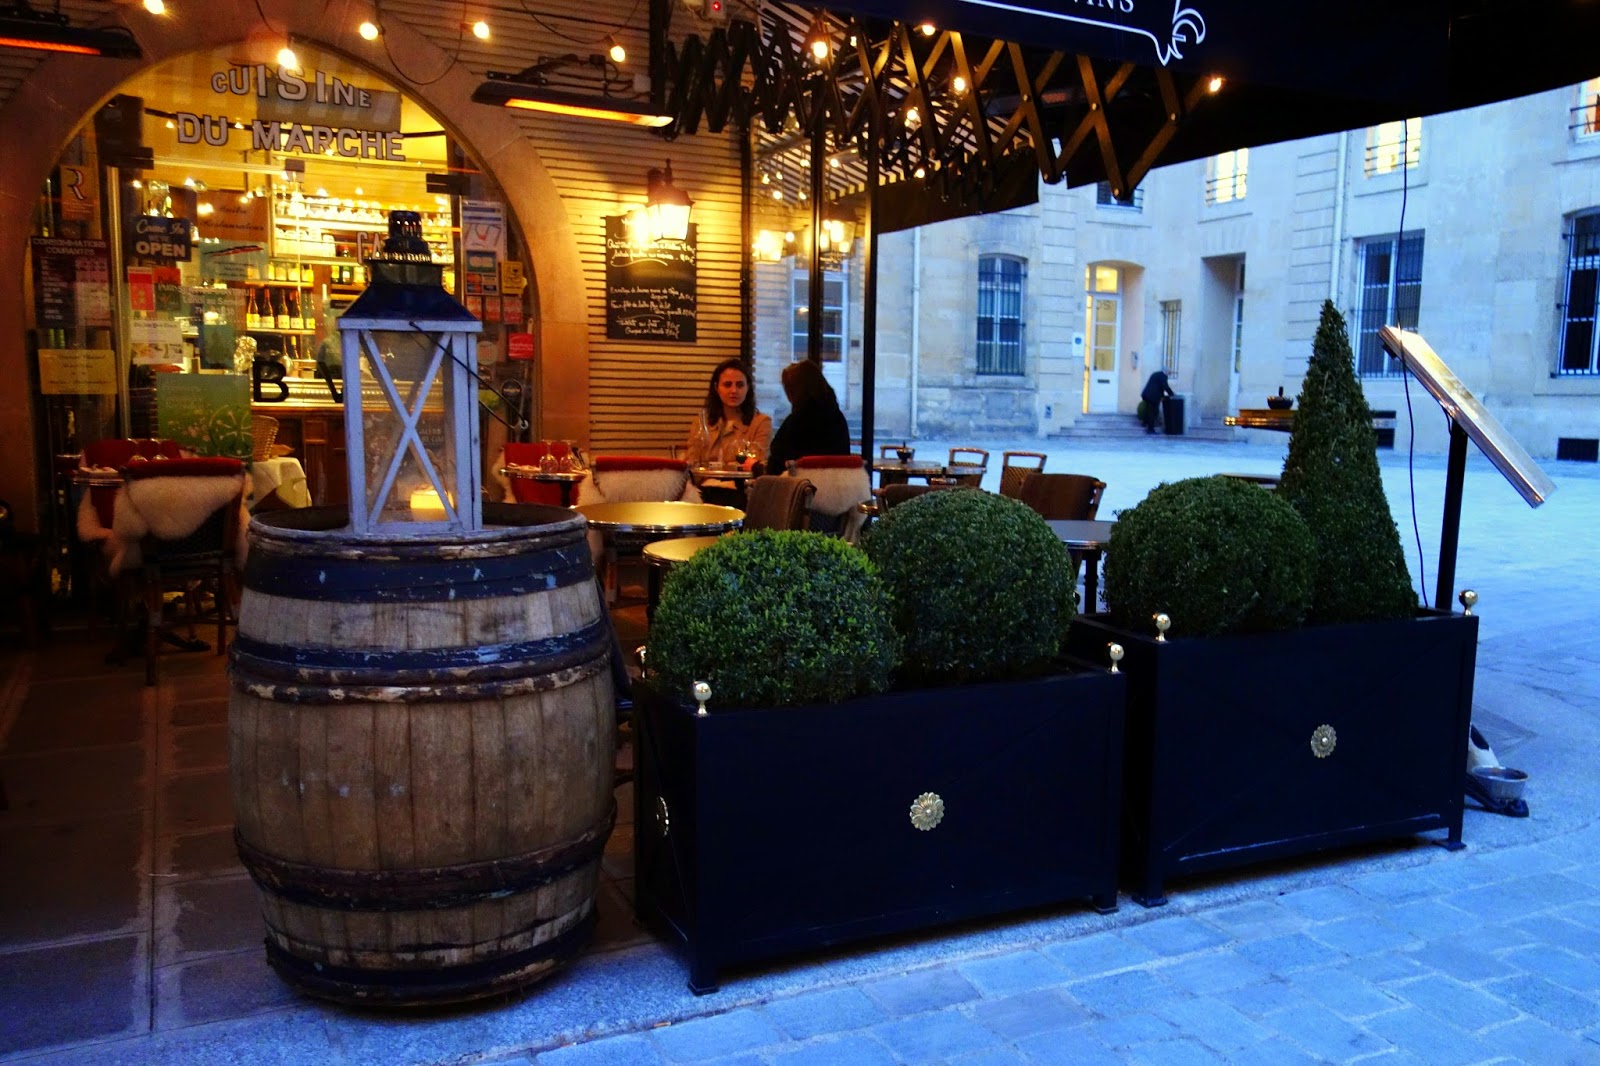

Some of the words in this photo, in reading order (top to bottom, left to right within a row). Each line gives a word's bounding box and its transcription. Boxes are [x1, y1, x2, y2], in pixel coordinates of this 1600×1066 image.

[1074, 0, 1134, 13] NS
[211, 64, 371, 109] CUISINE
[177, 111, 229, 147] DU
[252, 119, 405, 162] MARCHÉ
[32, 238, 107, 249] CONSOMMATIONS
[45, 246, 95, 256] COURANTES
[136, 241, 186, 258] OPEN
